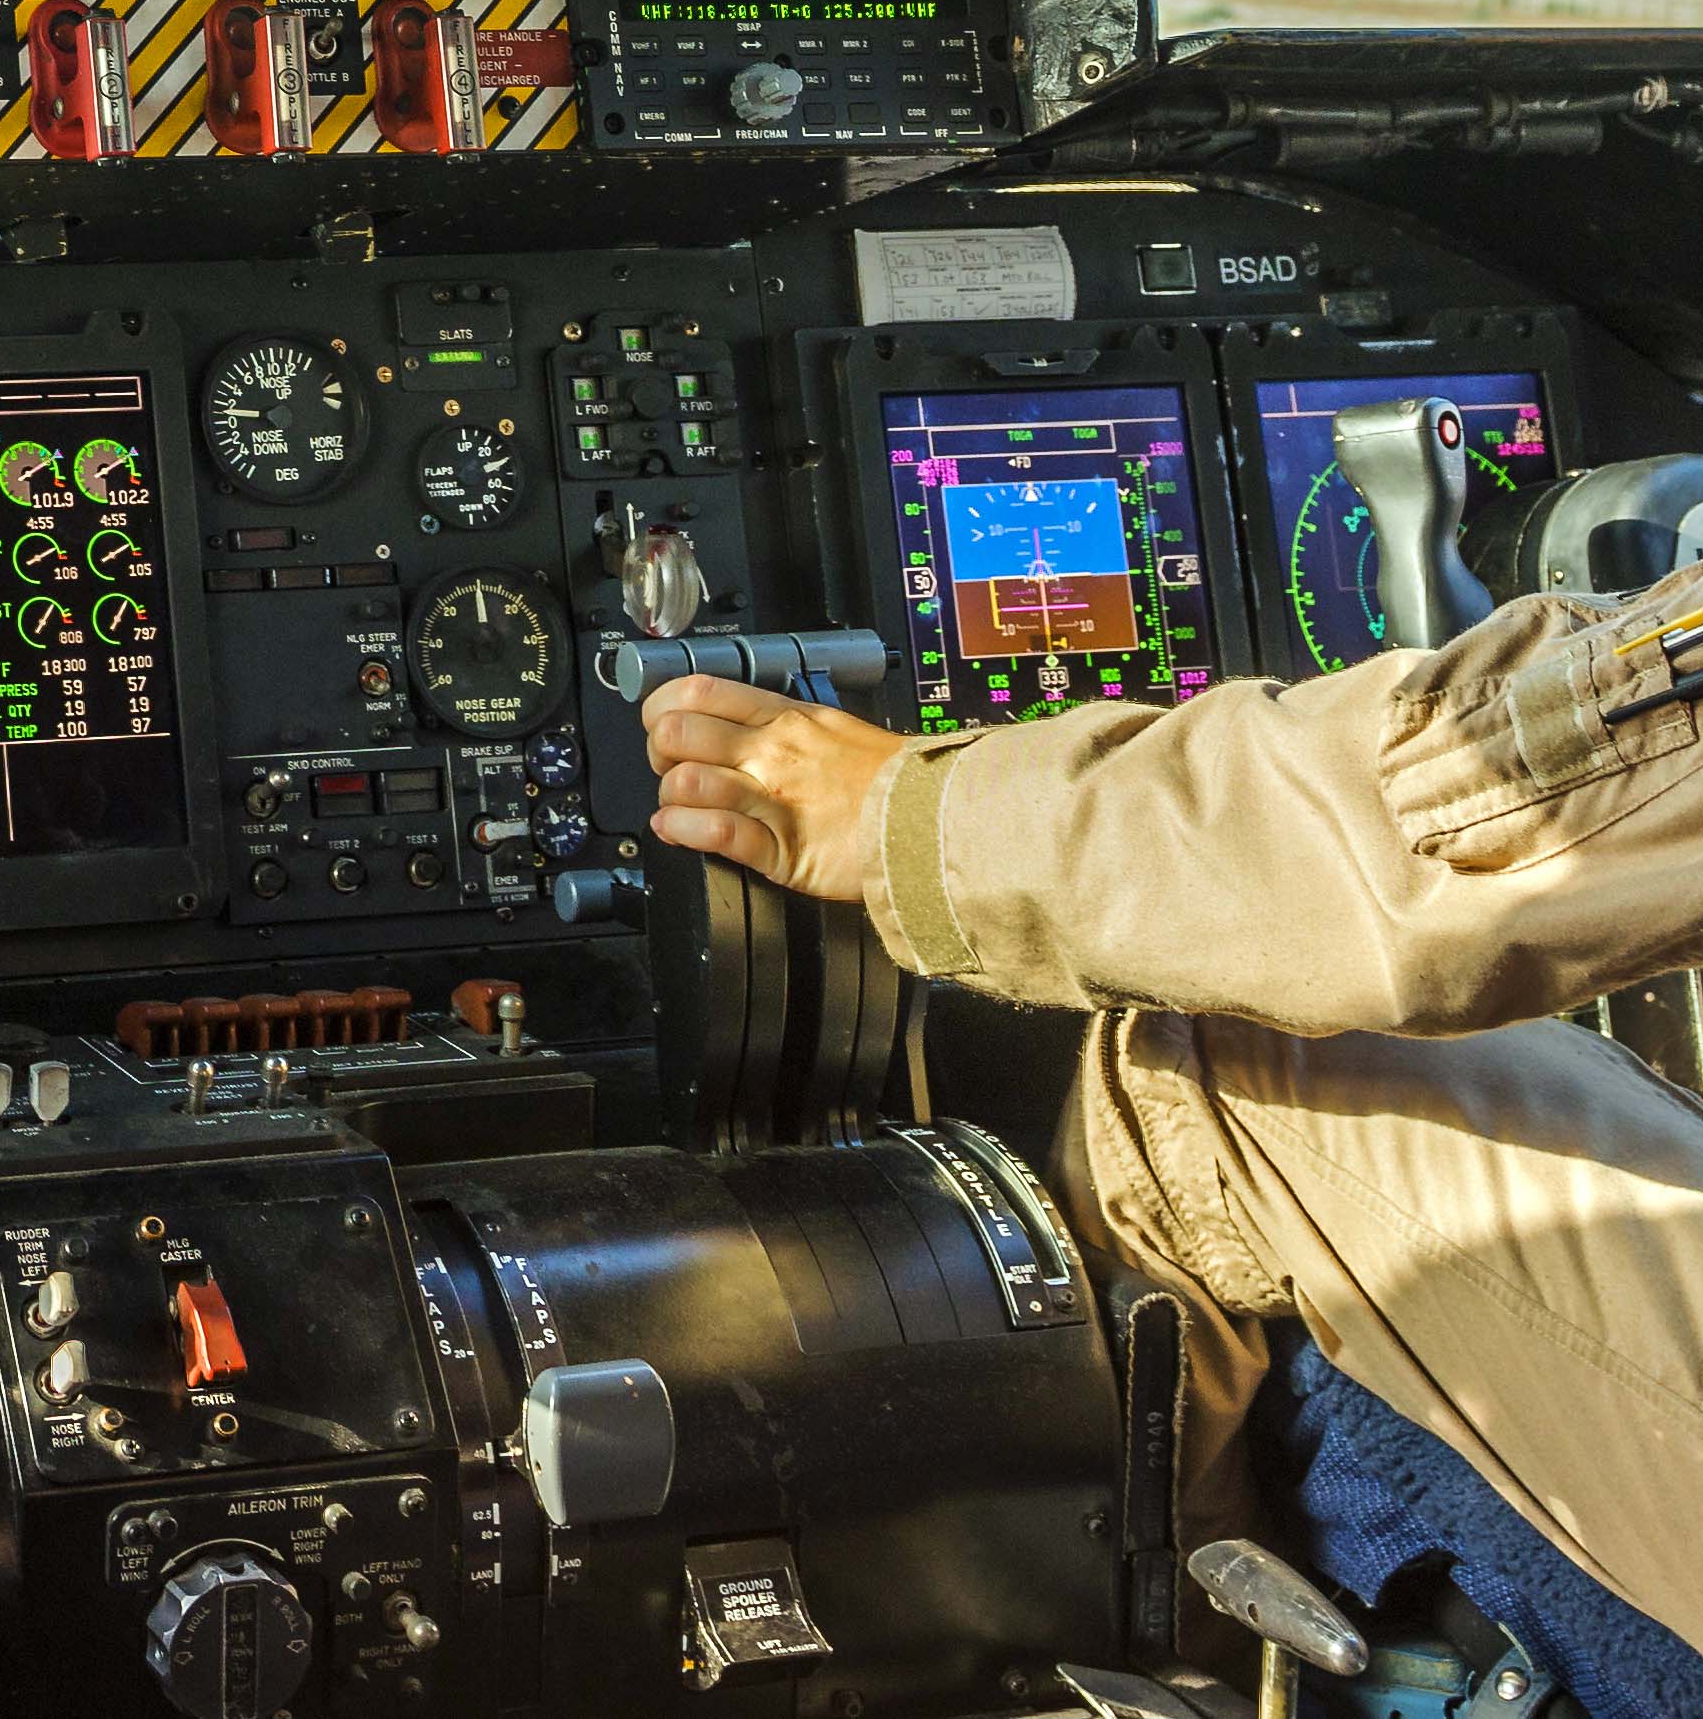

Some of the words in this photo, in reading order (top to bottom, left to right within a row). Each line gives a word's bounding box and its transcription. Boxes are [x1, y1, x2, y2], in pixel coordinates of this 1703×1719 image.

[665, 133, 692, 142] COMM
[736, 130, 788, 140] FREQ/CHAN
[1219, 256, 1296, 284] BSAD
[439, 329, 473, 341] SLATS
[284, 363, 296, 377] 12
[260, 376, 291, 389] NOSE
[276, 388, 291, 400] UP
[680, 401, 689, 412] R
[690, 401, 713, 411] FWD
[251, 430, 283, 443] NOSE
[310, 436, 342, 449] HORIZ
[254, 442, 288, 456] DOWN
[315, 448, 343, 461] STAB
[582, 451, 589, 461] L
[591, 450, 612, 460] AFT
[1016, 457, 1031, 468] FD
[275, 468, 299, 482] DEG
[424, 466, 453, 476] FLAPS
[129, 564, 152, 576] 105
[134, 628, 156, 640] 797
[346, 633, 366, 644] NLG
[368, 632, 397, 642] STEER
[1042, 672, 1066, 684] 333
[0, 683, 38, 697] PRESS
[456, 699, 486, 711] NOSE
[490, 698, 521, 709] GEAR
[464, 711, 516, 723] POSITION
[6, 725, 37, 738] TEMP
[57, 722, 87, 738] 100
[461, 746, 491, 757] BRAKE
[287, 760, 308, 770] SKID
[312, 757, 354, 768] CONTROL
[4, 1228, 50, 1240] RUDDER
[18, 1241, 44, 1251] TRIM
[167, 1238, 189, 1250] MLG
[160, 1249, 202, 1262] CASTER
[191, 1393, 236, 1406] CENTER
[228, 1498, 286, 1515] AILERON
[293, 1495, 323, 1509] TRIM
[291, 1528, 326, 1540] LOWER
[471, 1569, 493, 1580] LAND
[719, 1578, 773, 1594] GROUND
[721, 1591, 777, 1608] SPOILER
[724, 1604, 781, 1622] RELEASE
